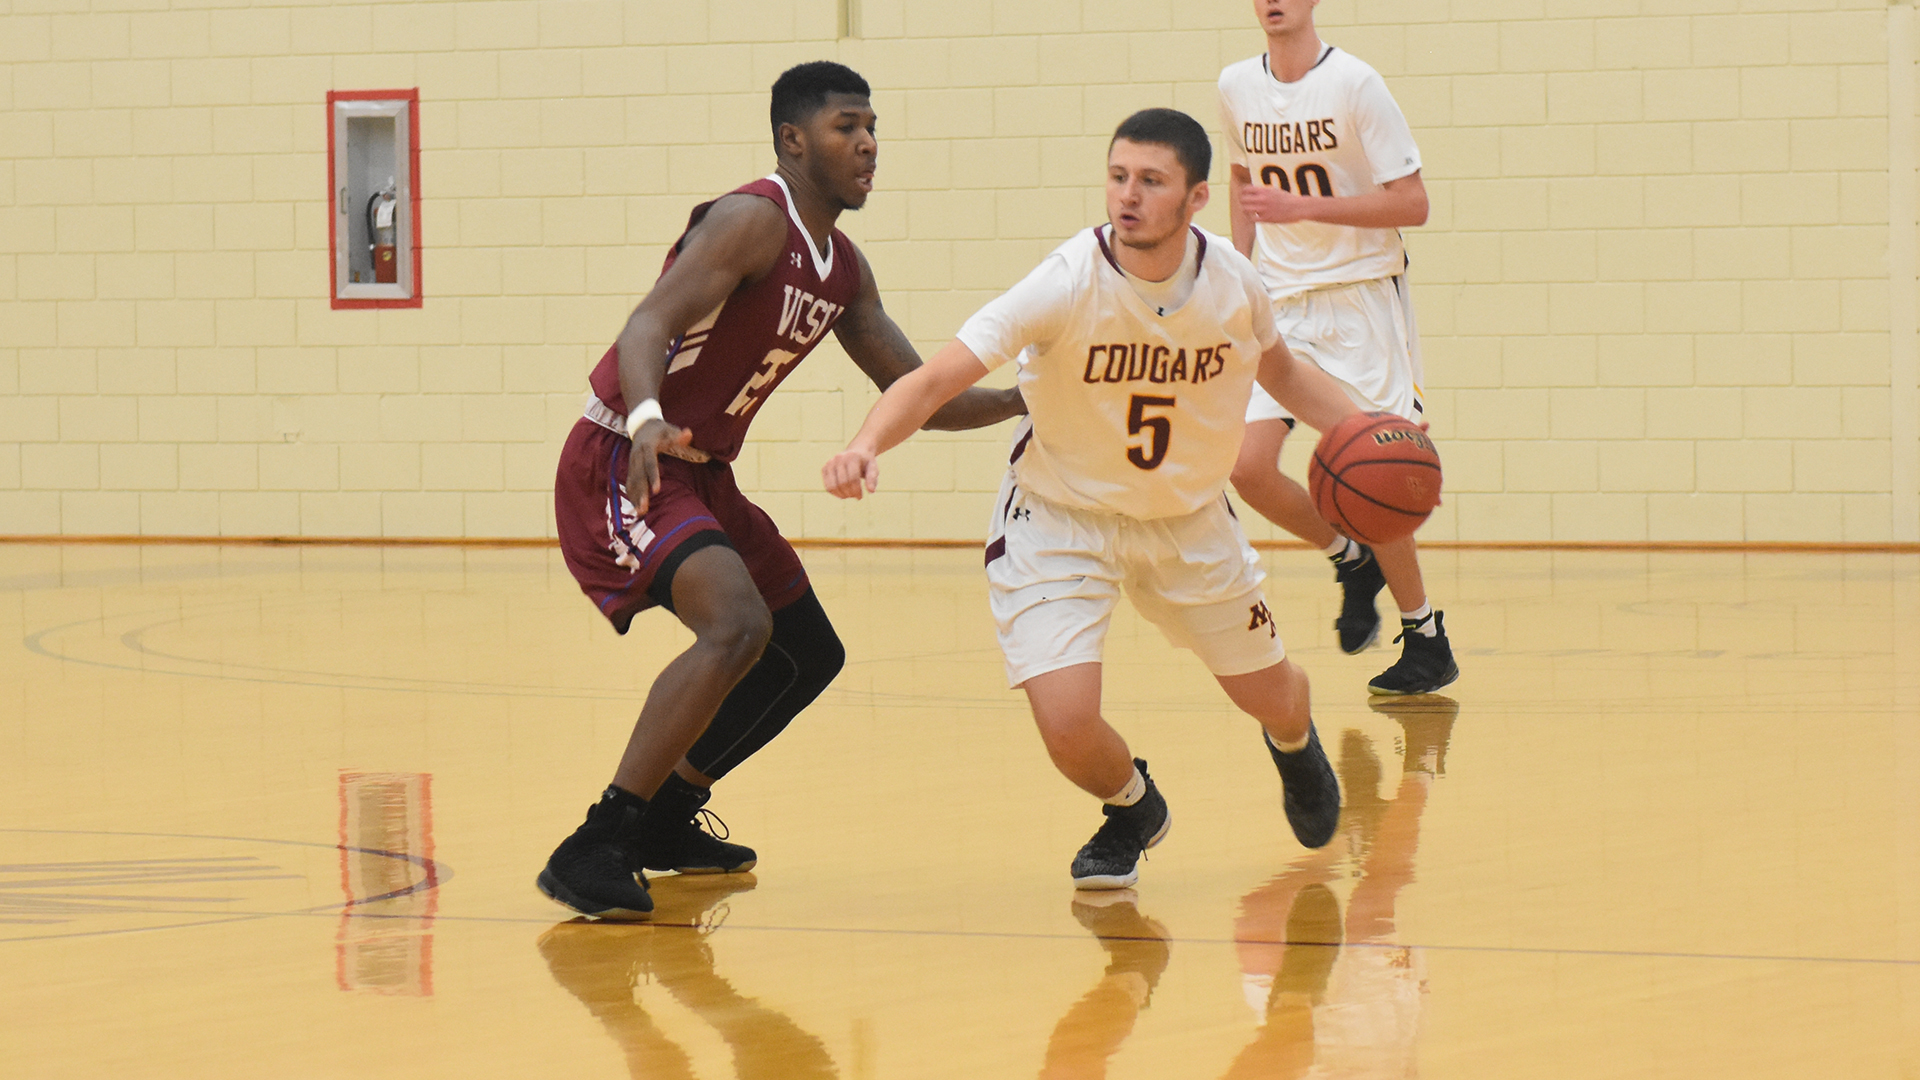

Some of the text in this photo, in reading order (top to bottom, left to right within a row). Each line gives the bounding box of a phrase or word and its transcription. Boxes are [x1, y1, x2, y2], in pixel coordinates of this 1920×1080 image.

[1244, 118, 1338, 154] COUGARS
[1083, 342, 1232, 384] COUGARS
[1126, 393, 1177, 471] 5
